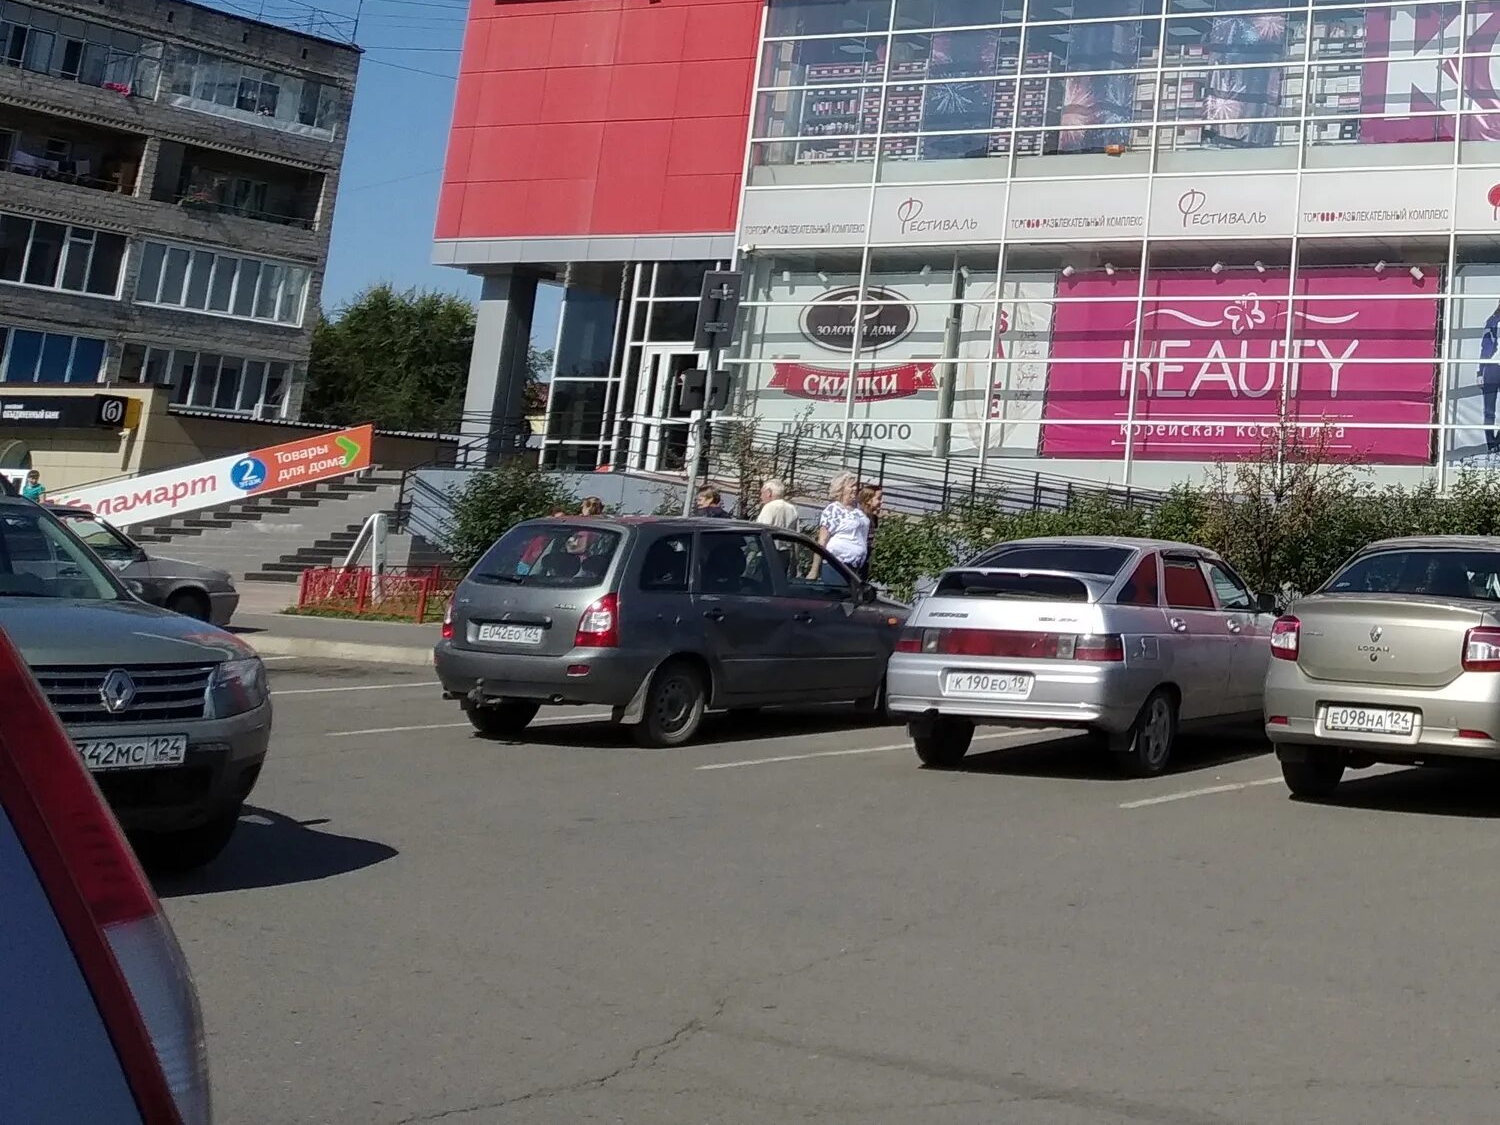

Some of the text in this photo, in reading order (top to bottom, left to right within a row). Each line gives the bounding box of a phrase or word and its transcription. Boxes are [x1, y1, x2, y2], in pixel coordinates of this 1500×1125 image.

[1408, 209, 1449, 221] КОМПЛЕКС
[870, 325, 897, 337] ДОМ
[274, 444, 329, 464] Товары
[244, 460, 258, 481] 2
[278, 455, 347, 483] для дома
[1387, 711, 1410, 726] 124
[150, 738, 182, 756] 124
